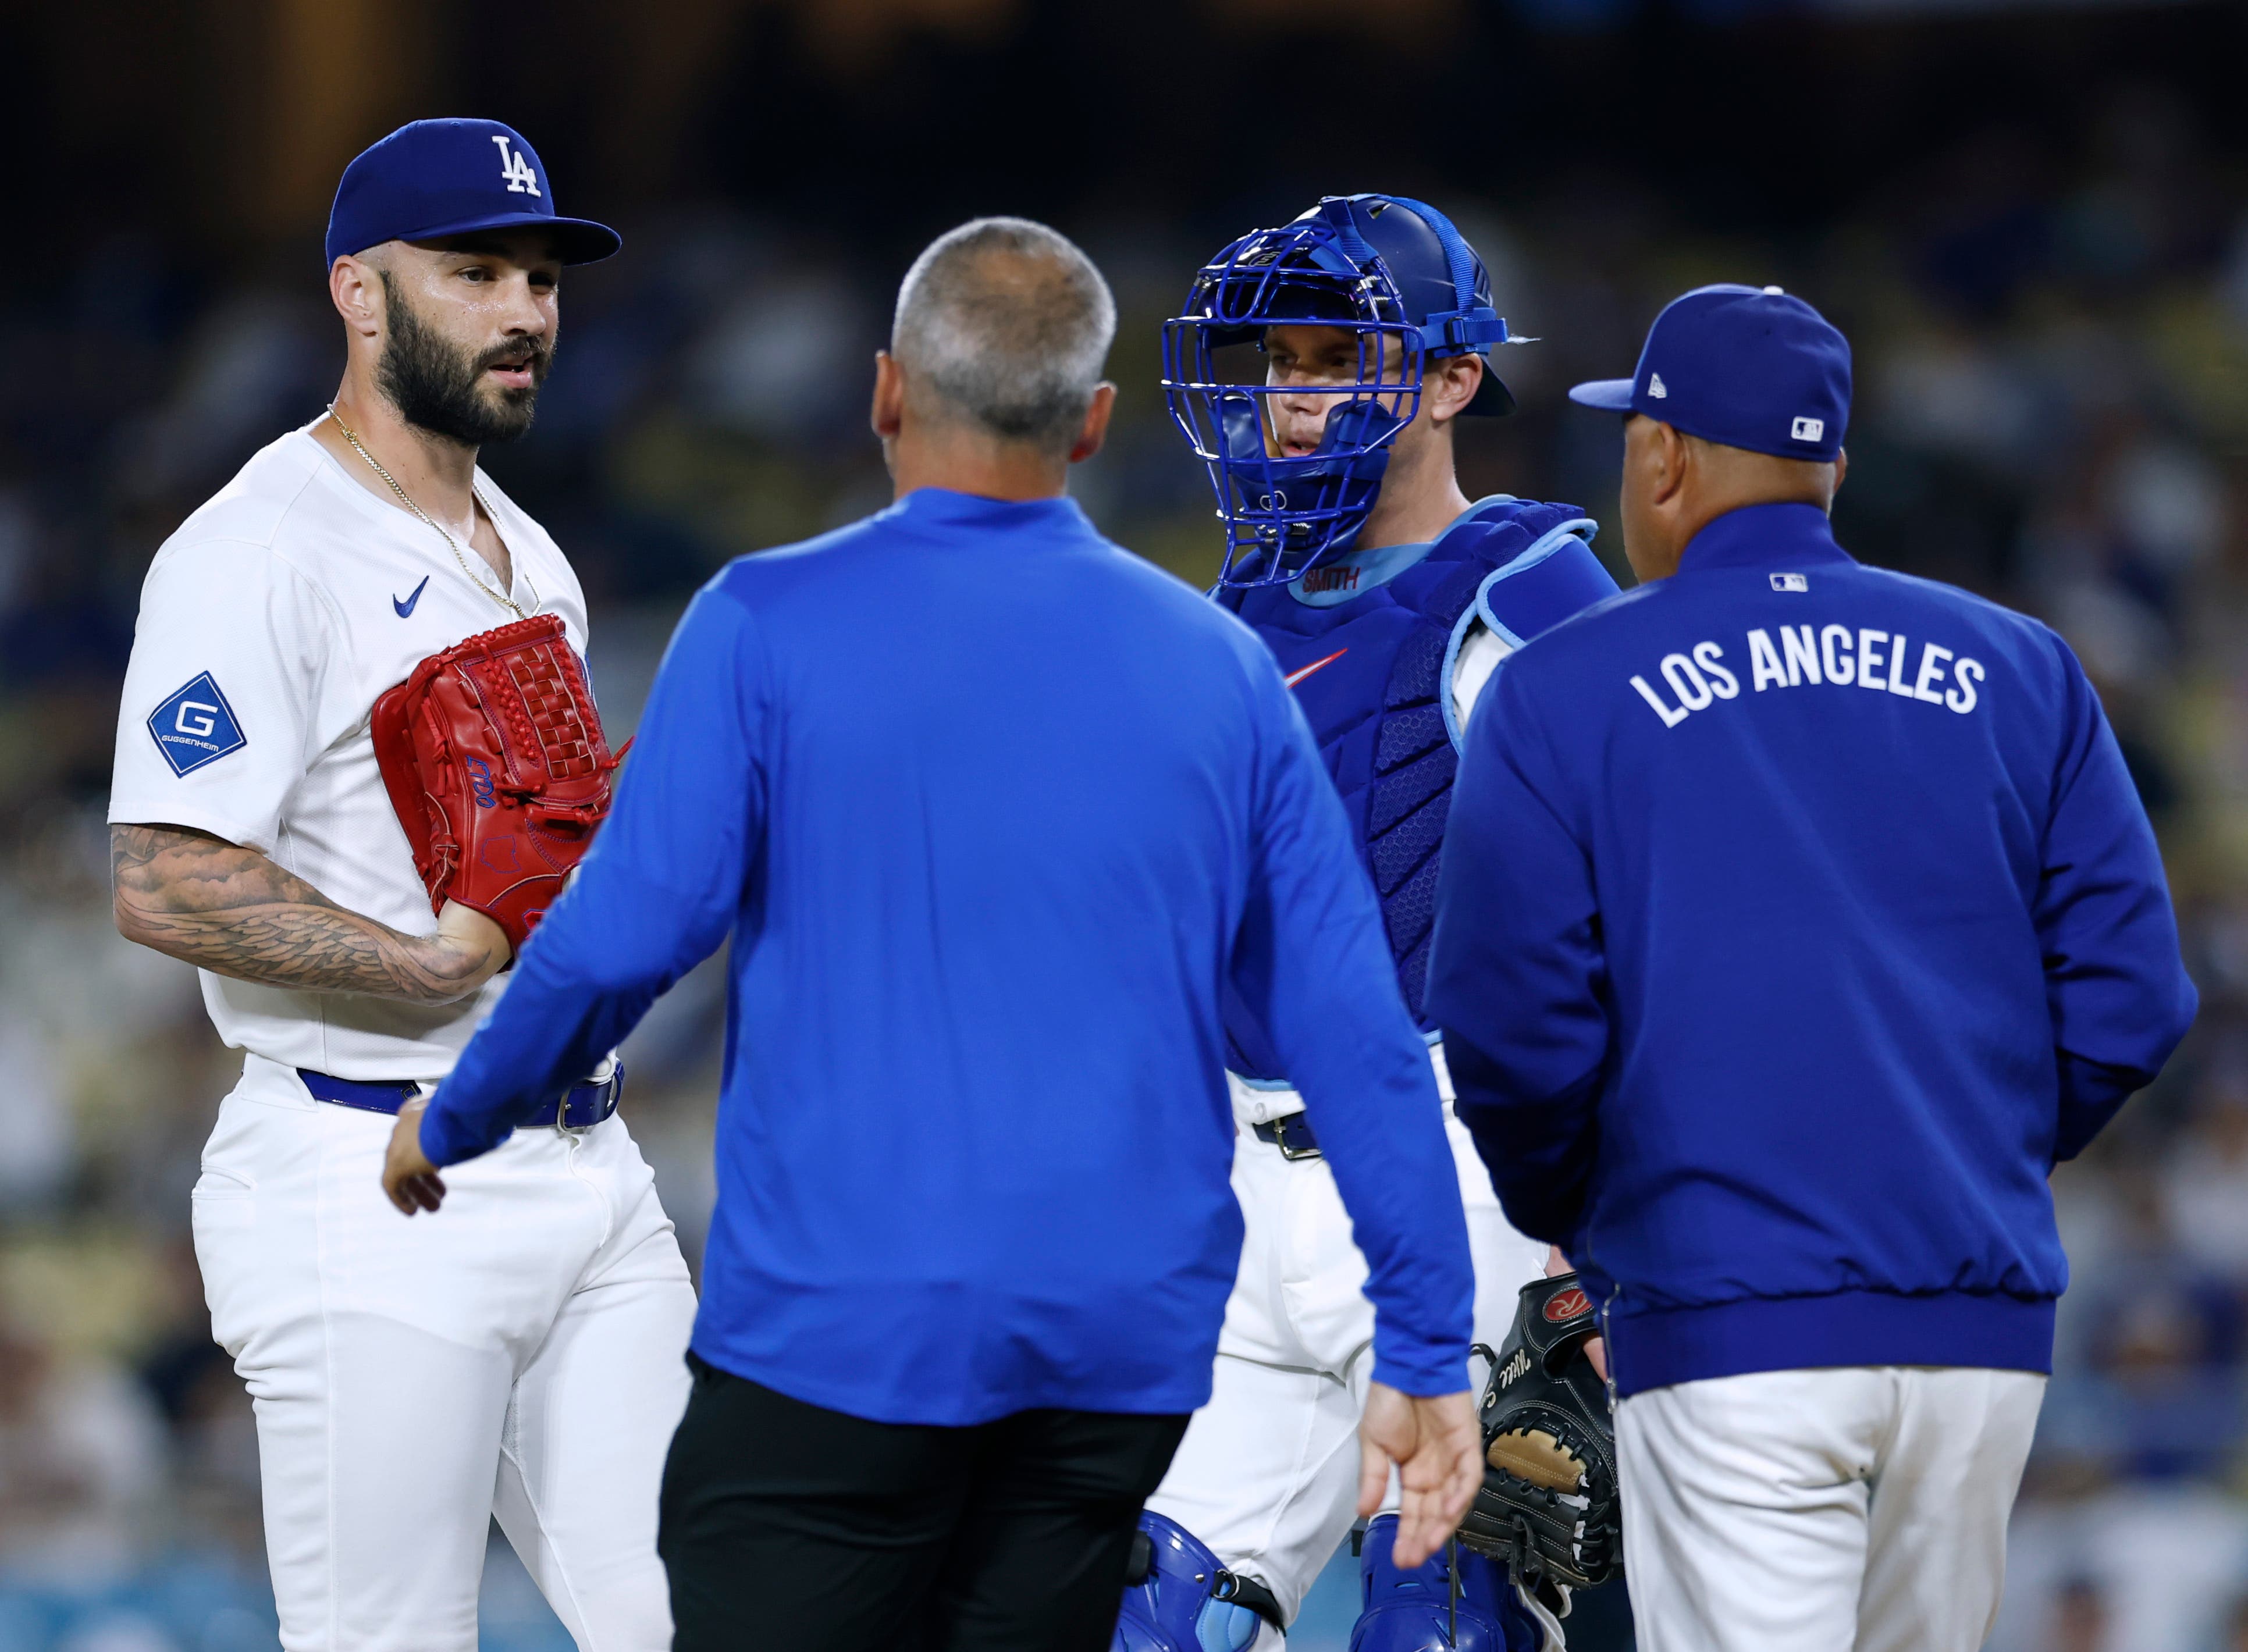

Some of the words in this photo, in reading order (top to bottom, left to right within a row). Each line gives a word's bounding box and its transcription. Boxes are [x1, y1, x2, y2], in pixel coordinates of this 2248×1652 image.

[492, 136, 541, 198] LA
[1303, 567, 1361, 593] SMITH
[1630, 641, 1740, 729] LOS
[1747, 624, 1986, 714] ANGELES
[175, 700, 218, 737] G
[161, 735, 219, 752] GUGGENHEIM
